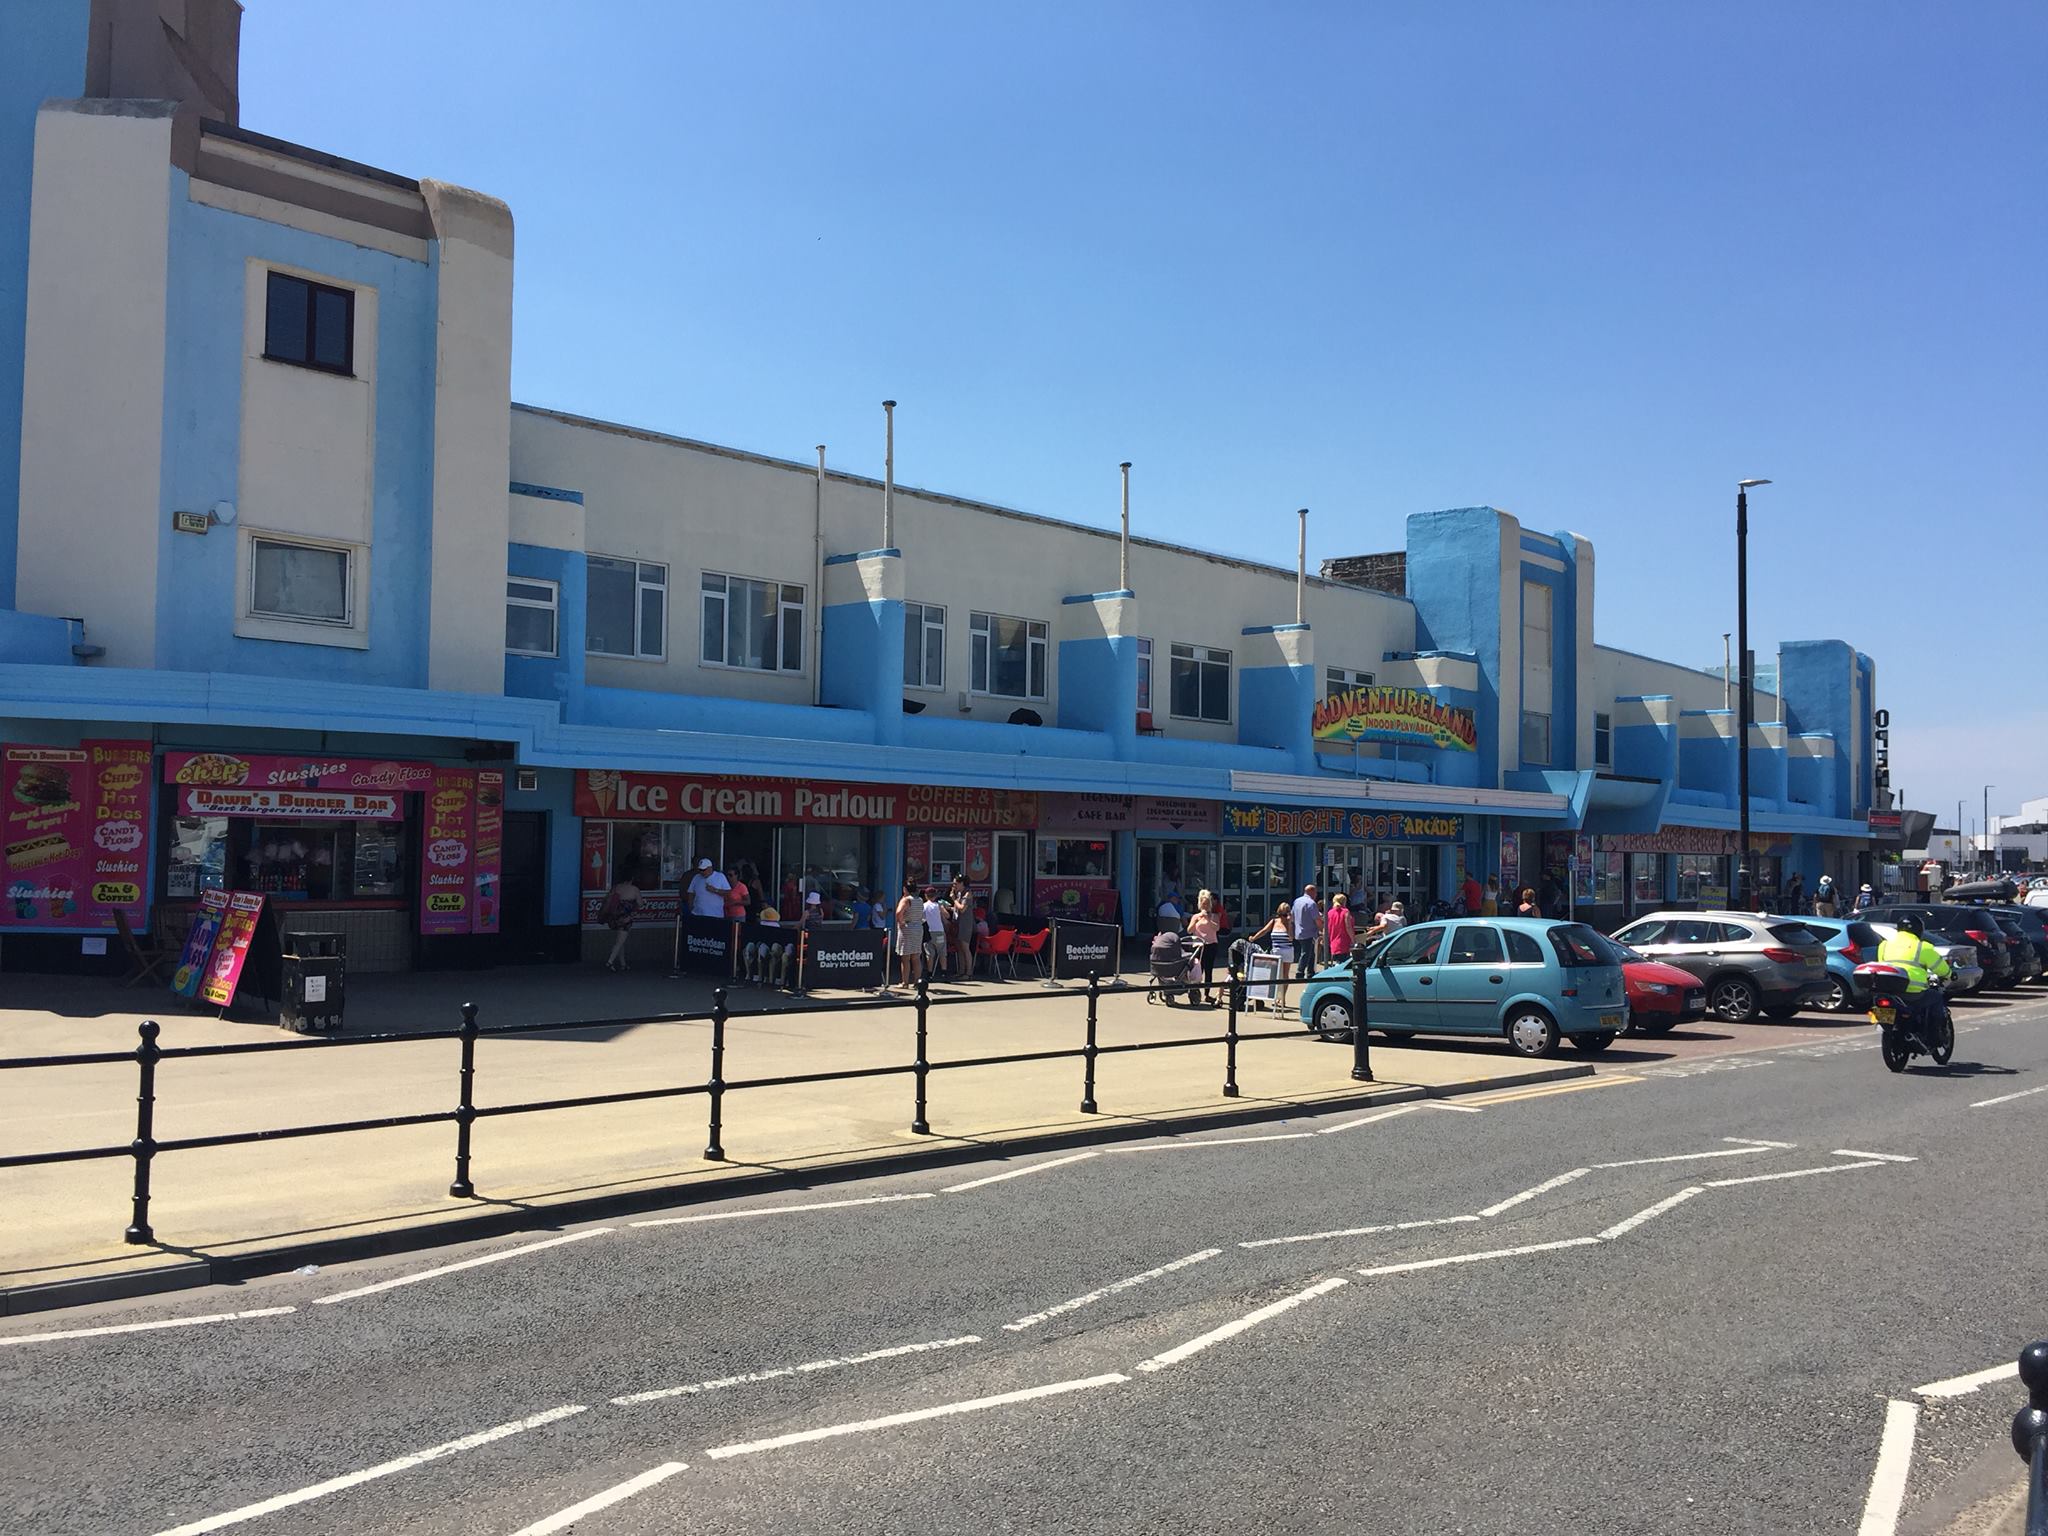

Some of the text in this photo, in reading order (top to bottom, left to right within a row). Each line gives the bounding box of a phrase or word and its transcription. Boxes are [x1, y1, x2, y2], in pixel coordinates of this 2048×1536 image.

[1314, 686, 1475, 744] ADVENTURELAND
[176, 761, 250, 784] Chips
[267, 763, 431, 786] Slushies Candy Floss
[616, 780, 896, 819] Ice Cream Parlour
[908, 785, 989, 805] COFFEE &
[906, 805, 1013, 825] DOUGHNUTS
[1105, 811, 1126, 820] BAR
[1232, 808, 1457, 839] THE BRIGHT SPOT ARCADE
[100, 827, 136, 836] CANDY
[103, 837, 134, 845] FLOSS
[433, 845, 461, 853] CANDY
[435, 853, 460, 861] FLOSS
[96, 859, 139, 873] Slushies
[429, 874, 464, 885] Slushies
[6, 886, 74, 899] Slushies
[99, 885, 133, 894] TEA &
[98, 894, 134, 902] COFFEE
[432, 895, 460, 903] TEA &
[687, 934, 726, 950] Beechdean
[1066, 944, 1109, 954] Beechdean
[817, 950, 873, 961] Beechdean
[819, 961, 839, 969] Dairy
